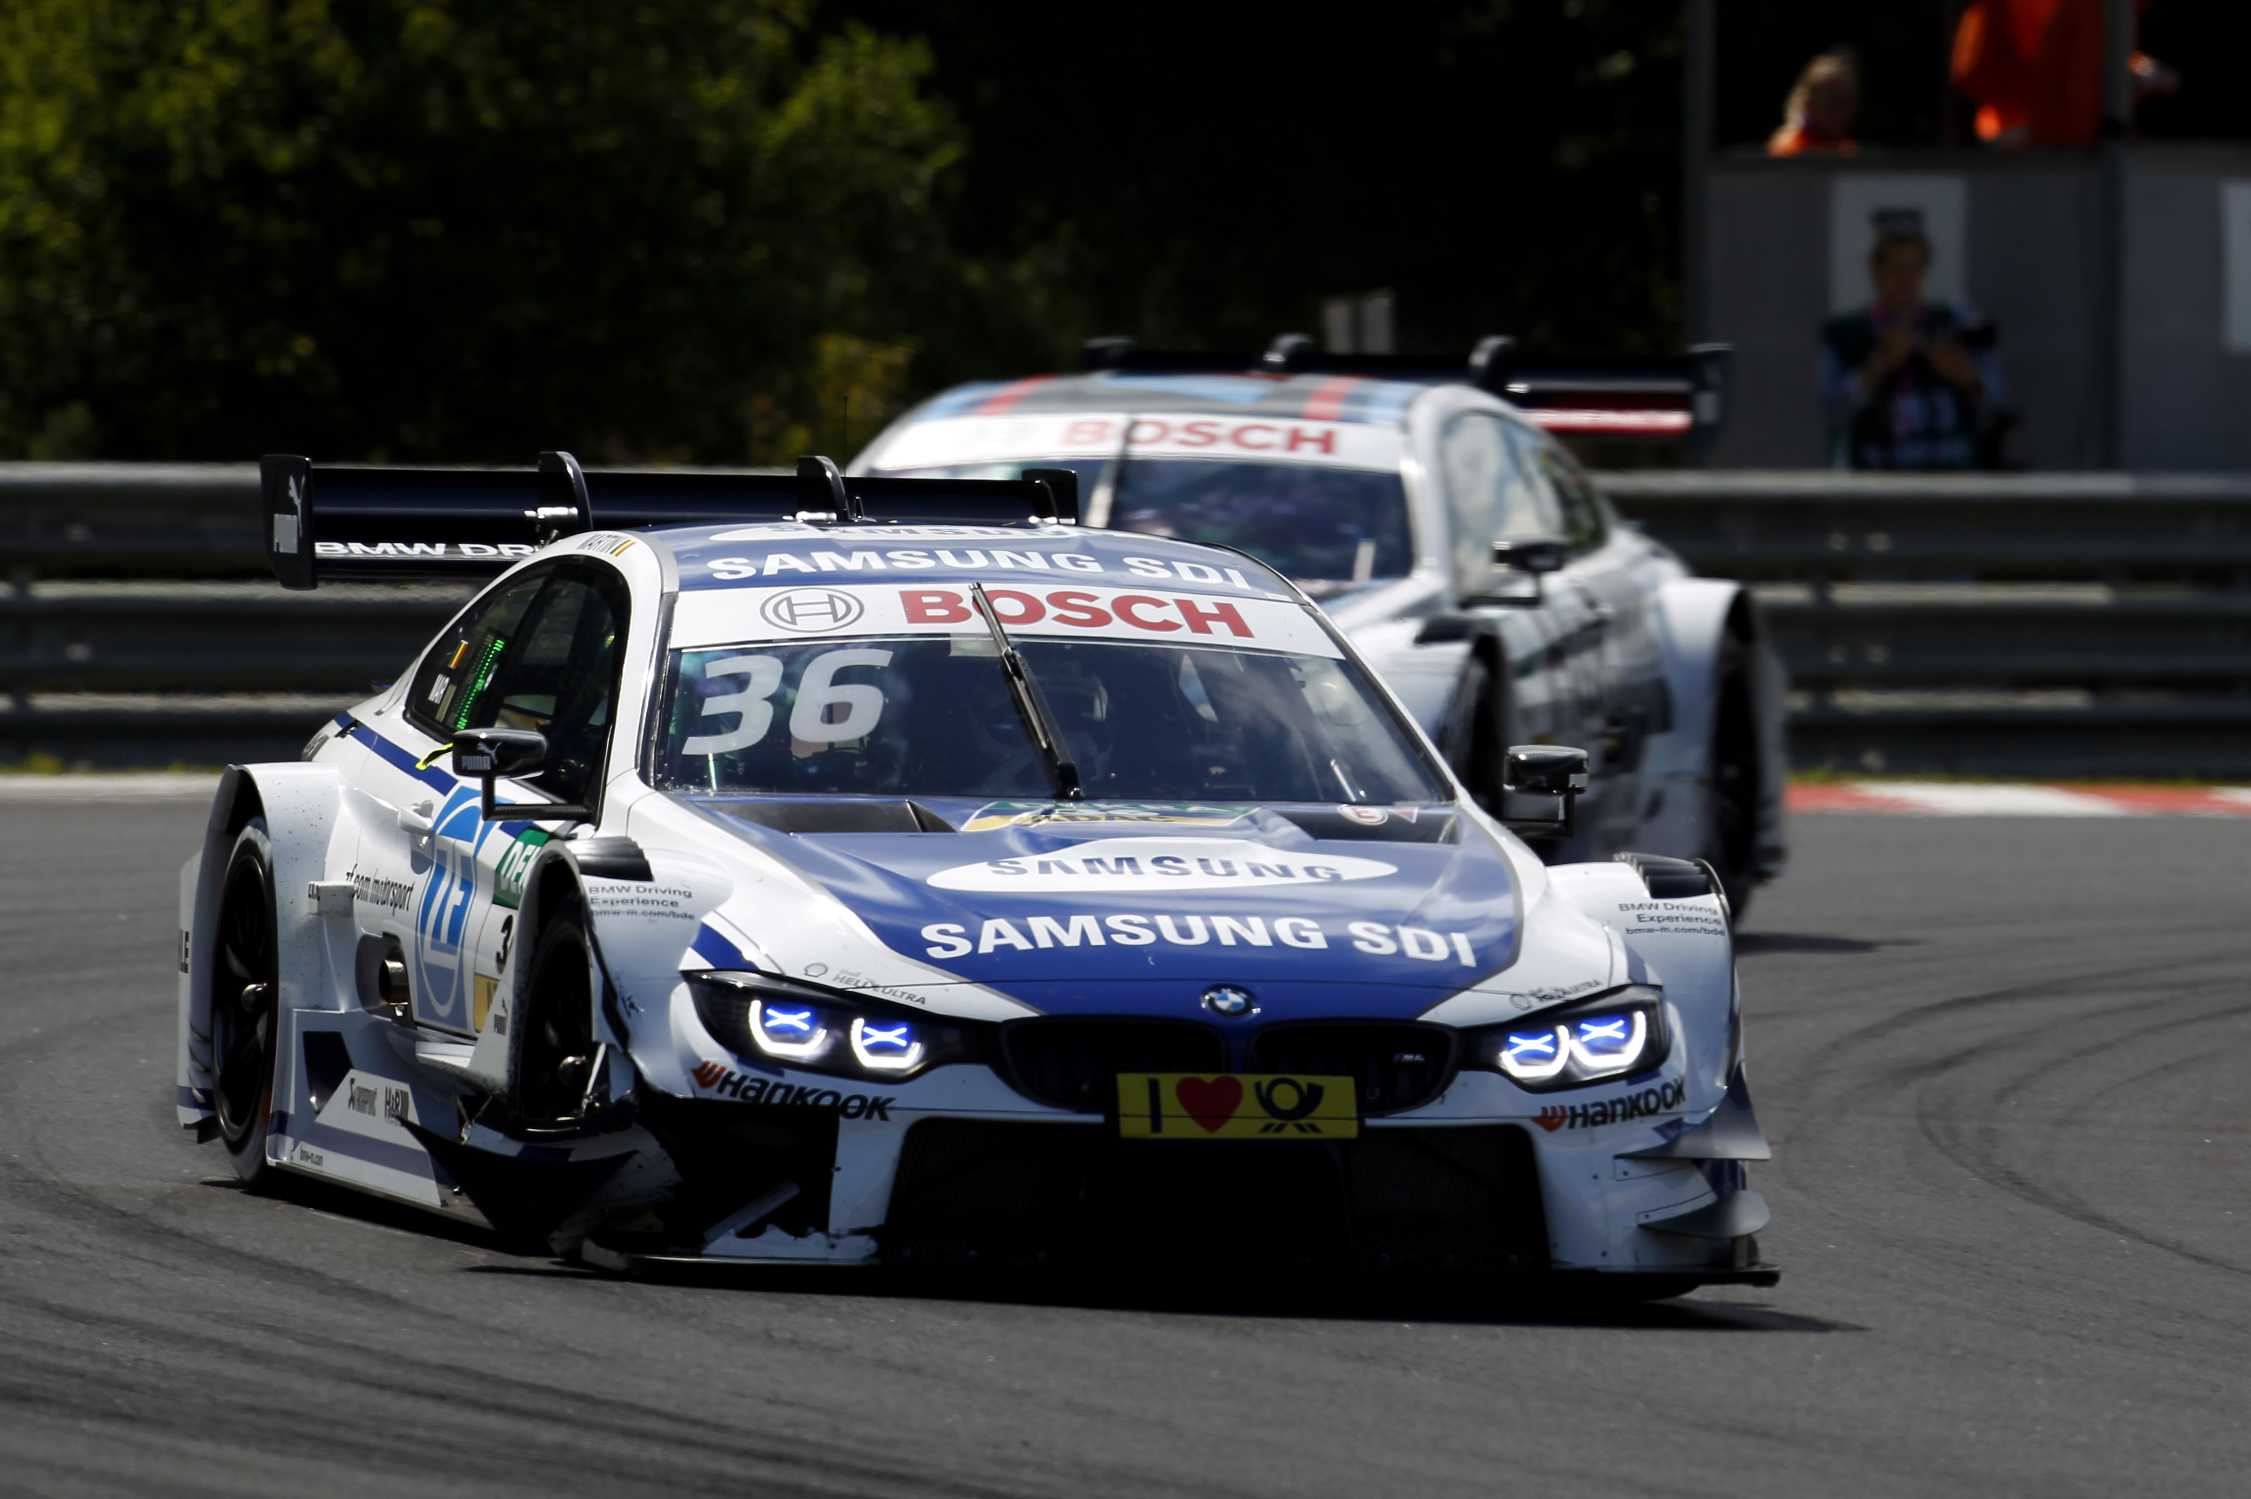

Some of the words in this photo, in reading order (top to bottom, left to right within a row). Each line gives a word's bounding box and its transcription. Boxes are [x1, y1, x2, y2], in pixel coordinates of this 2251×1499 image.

[1064, 420, 1338, 455] BOSCH
[313, 541, 448, 558] BMW
[706, 550, 1105, 580] SAMSUNG
[1135, 555, 1252, 589] SDI
[898, 589, 1255, 638] BOSCH
[681, 648, 894, 757] 36
[985, 855, 1345, 882] SAMSUNG
[426, 838, 477, 972] ZF
[588, 886, 631, 894] BMW
[636, 886, 693, 898] Driving
[590, 897, 680, 908] Experience
[1618, 903, 1659, 912] BMW
[1664, 903, 1718, 916] Driving
[1636, 913, 1722, 924] Experience
[496, 914, 515, 974] 3
[920, 913, 1329, 959] SAMSUNG
[1346, 921, 1477, 968] SDI
[879, 986, 927, 1005] ULTRA
